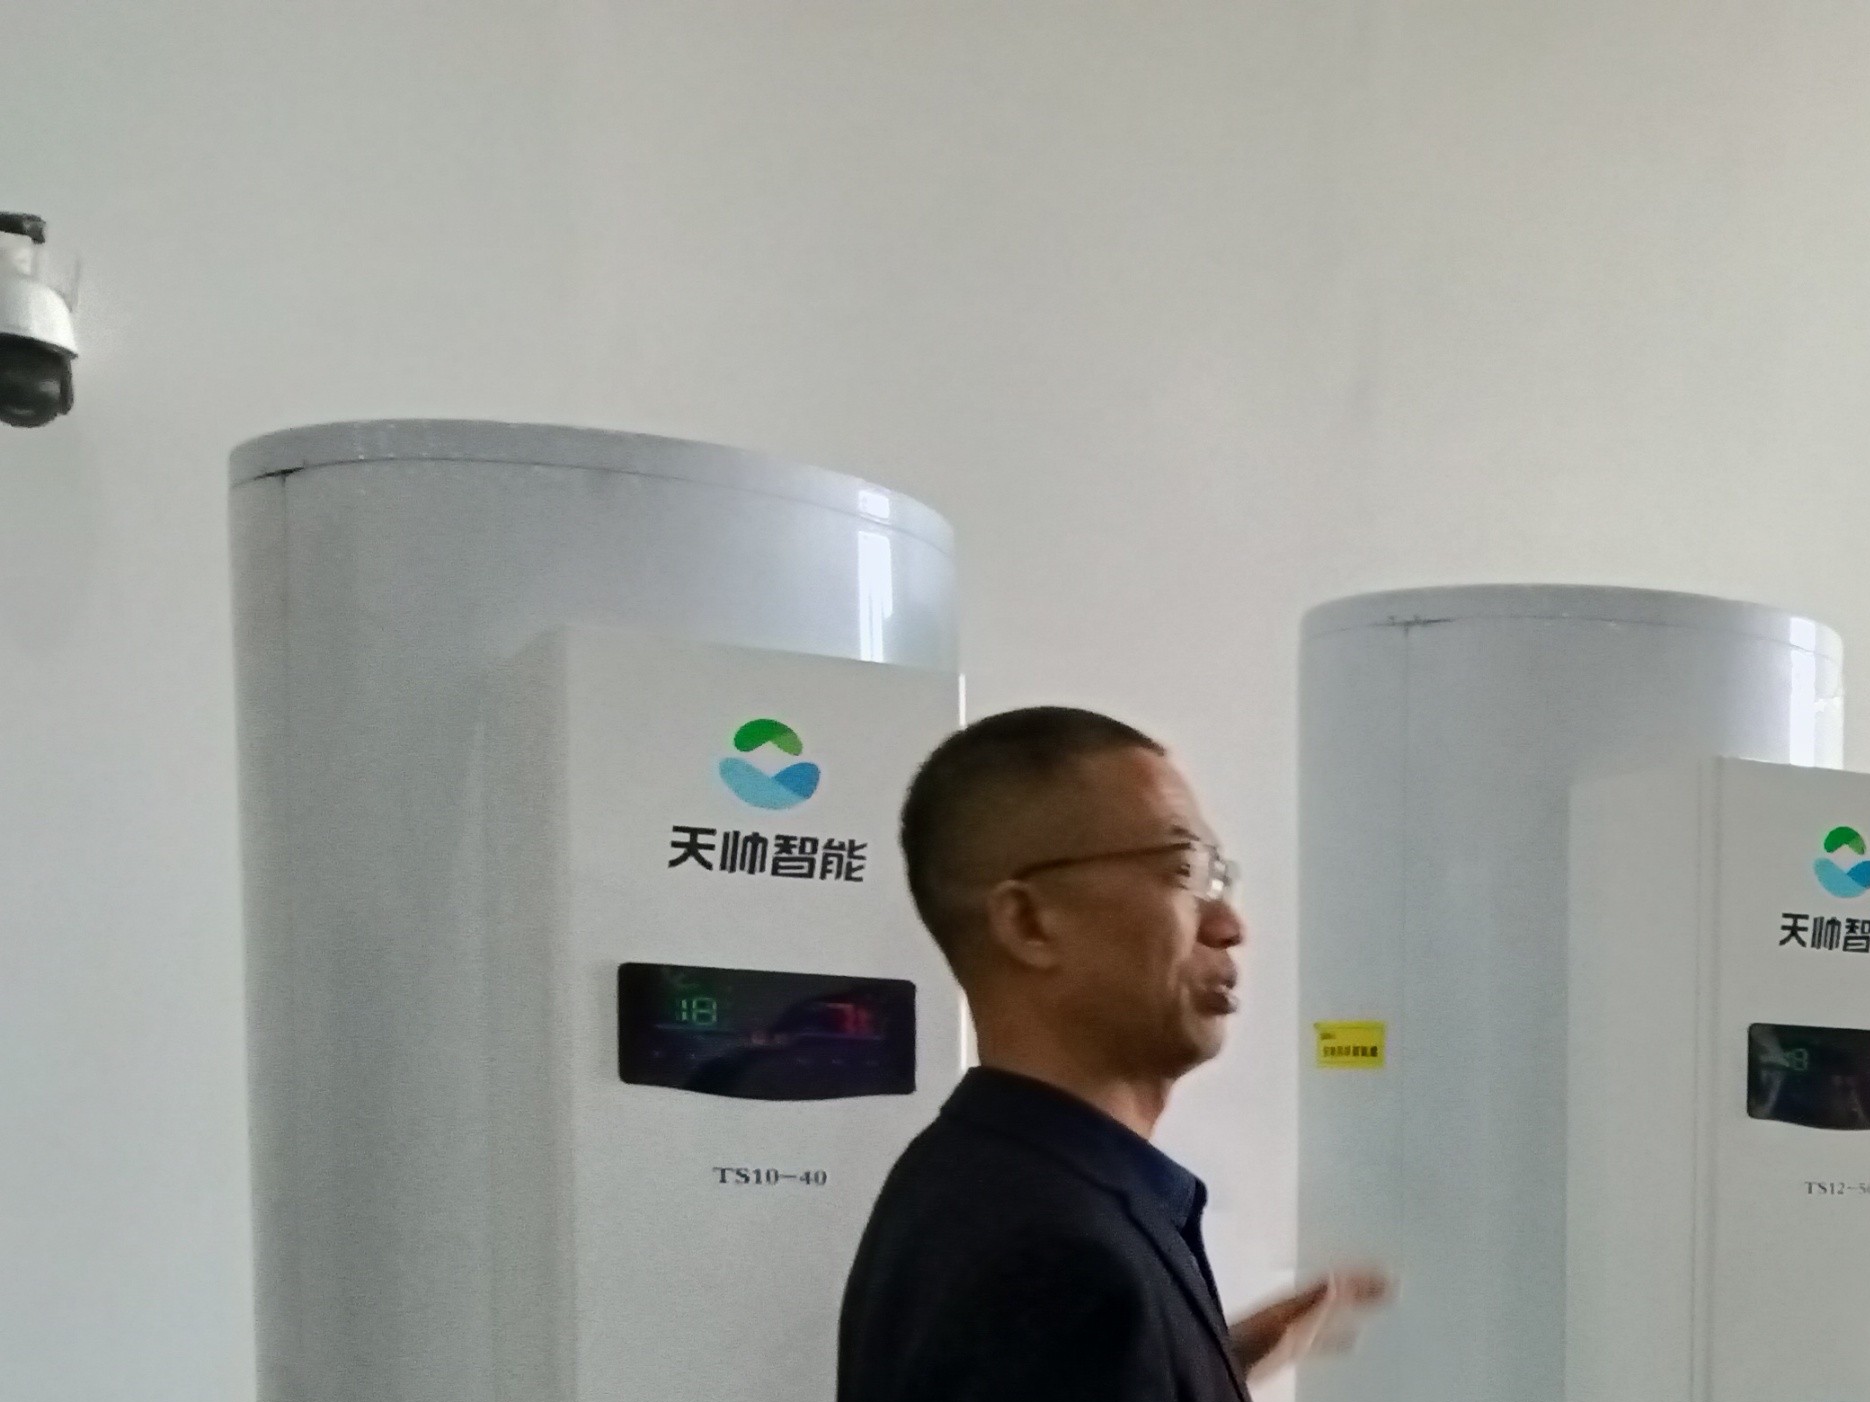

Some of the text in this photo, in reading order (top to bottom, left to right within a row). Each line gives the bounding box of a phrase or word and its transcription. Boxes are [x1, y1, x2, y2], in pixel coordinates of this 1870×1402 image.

[668, 824, 868, 884] 天帅智能
[712, 1166, 828, 1185] TS10-40
